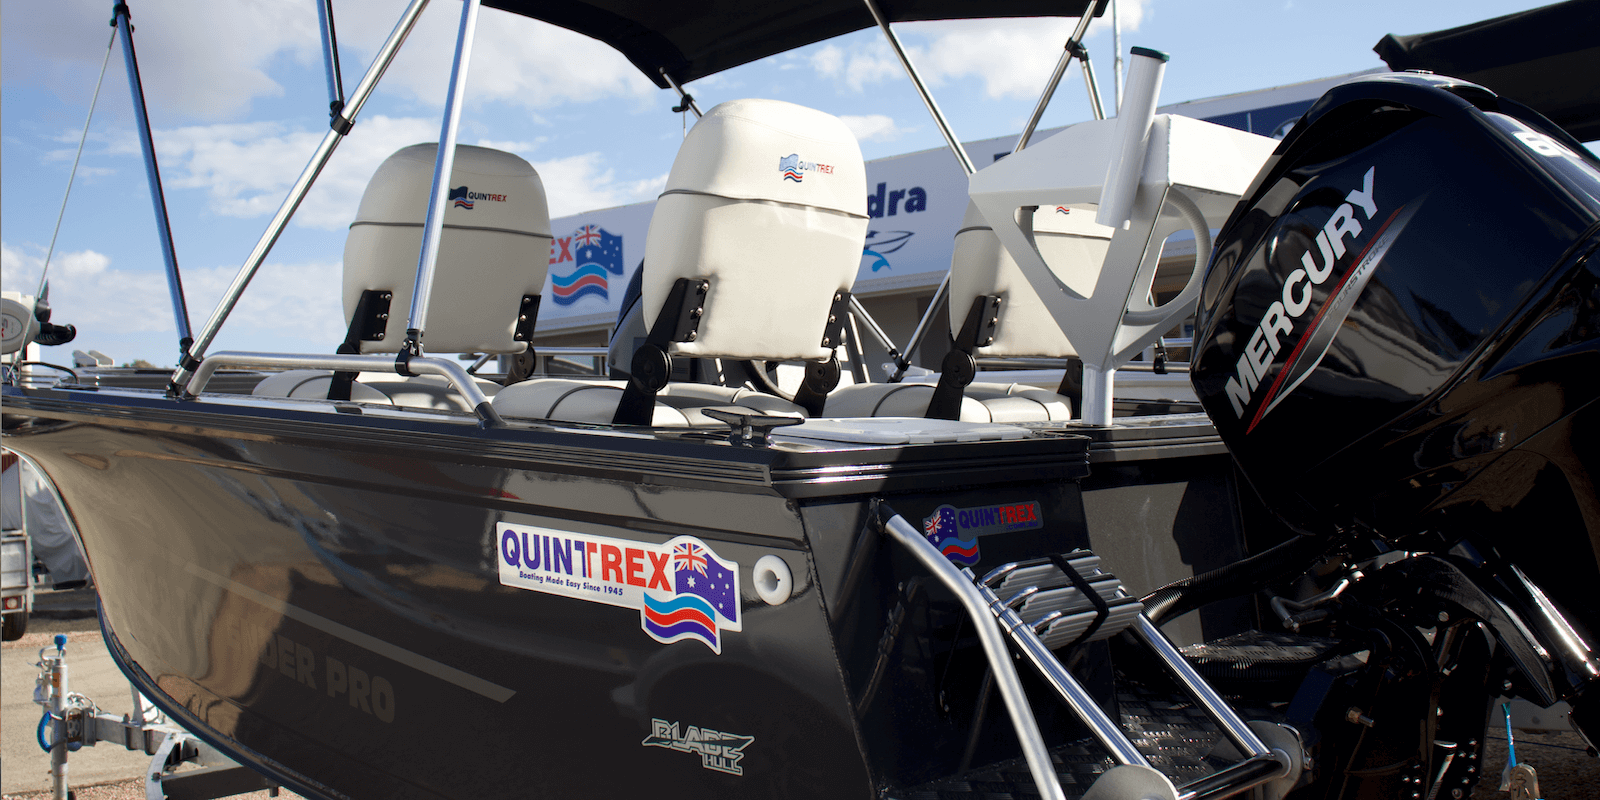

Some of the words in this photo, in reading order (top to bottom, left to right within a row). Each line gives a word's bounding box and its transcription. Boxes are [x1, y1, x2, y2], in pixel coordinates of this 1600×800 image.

[798, 161, 835, 175] QUINTREX
[468, 191, 507, 203] QUINTREX
[1224, 165, 1378, 420] MERCURY
[958, 503, 1037, 529] QUINTREX
[501, 529, 673, 592] QUINTREX
[519, 570, 544, 584] Boating
[545, 575, 564, 586] Made
[566, 578, 581, 590] Easy
[582, 582, 601, 592] Since
[603, 585, 624, 596] 1945
[326, 655, 396, 724] PRO
[652, 719, 754, 760] BLADE
